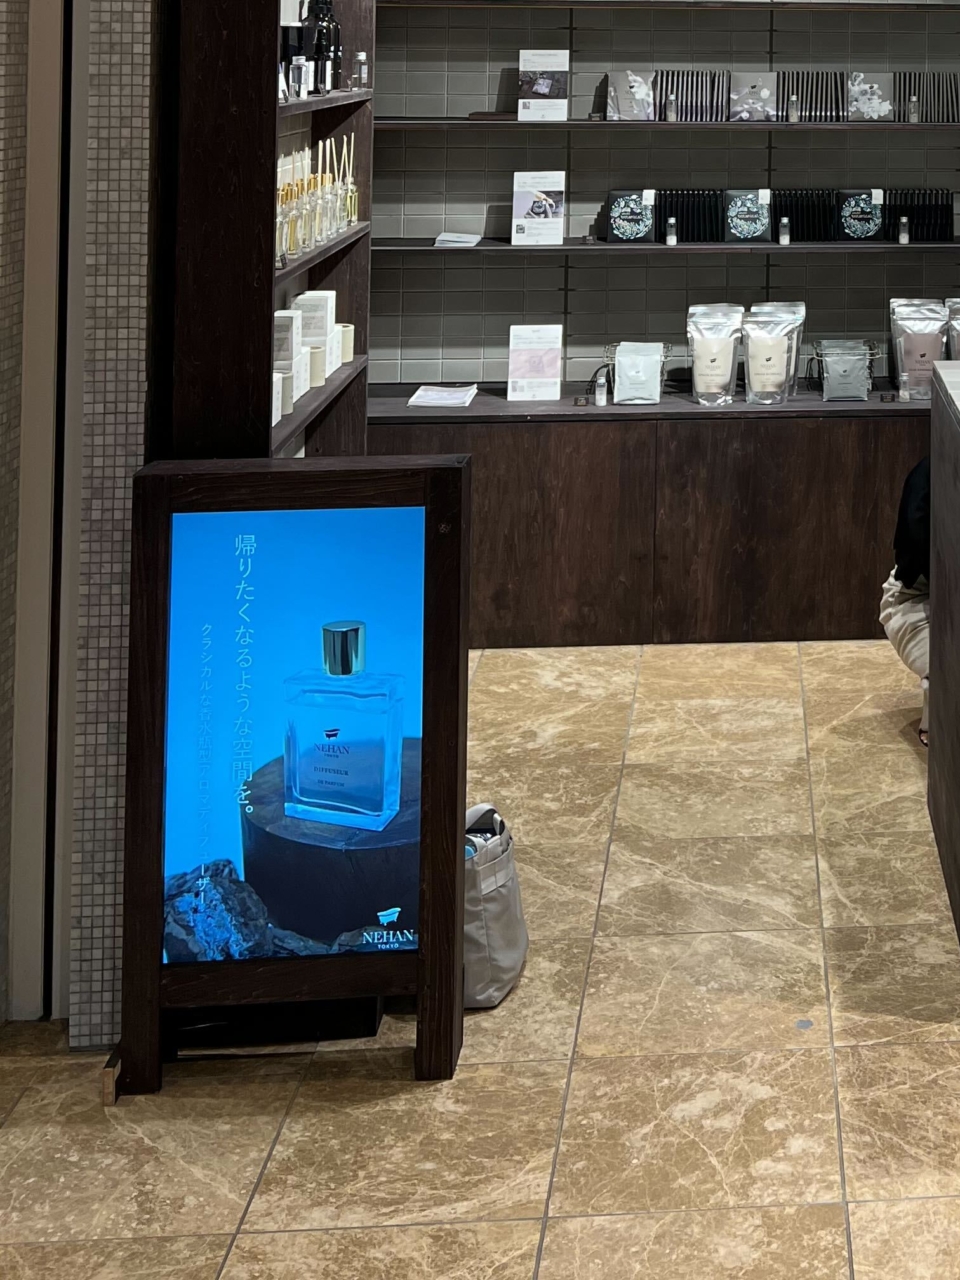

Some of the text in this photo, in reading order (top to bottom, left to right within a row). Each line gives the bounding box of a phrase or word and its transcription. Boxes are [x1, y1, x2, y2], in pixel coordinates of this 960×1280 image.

[232, 534, 257, 814] 帰りたくなるような空間を。
[314, 743, 351, 755] NEHAN
[362, 928, 414, 944] NEHAN
